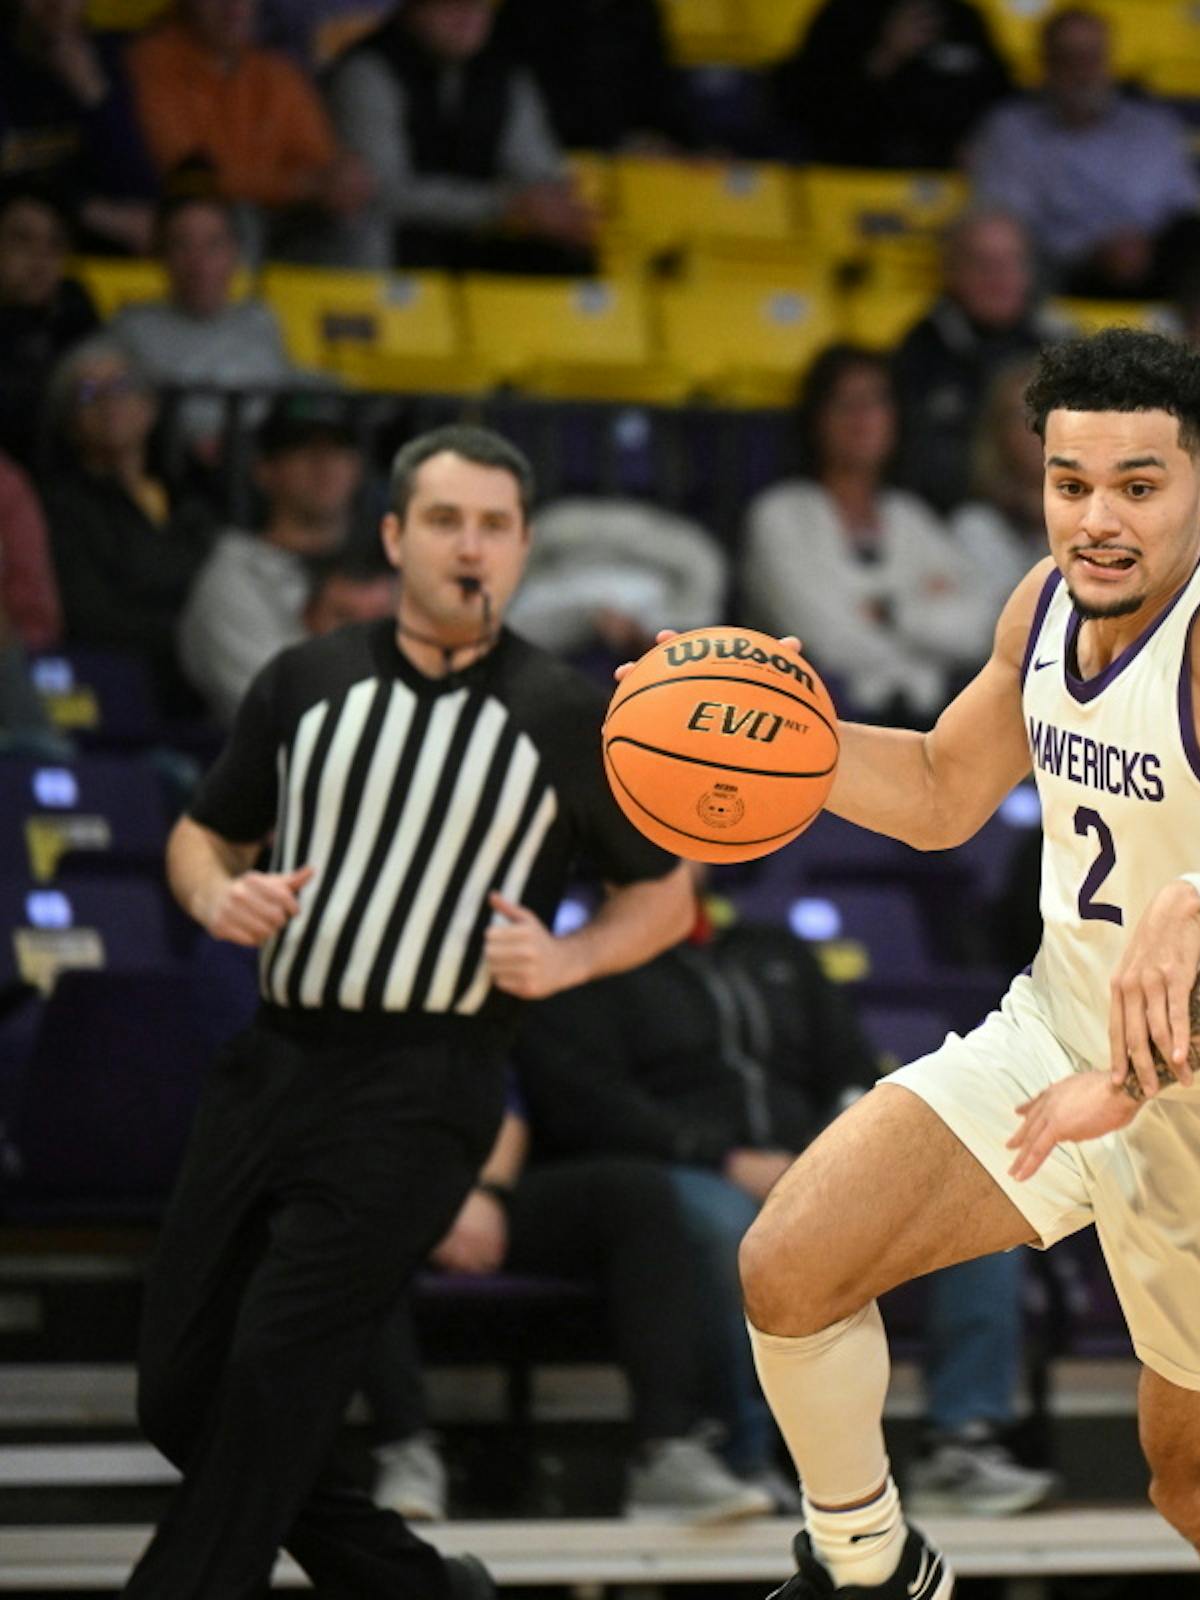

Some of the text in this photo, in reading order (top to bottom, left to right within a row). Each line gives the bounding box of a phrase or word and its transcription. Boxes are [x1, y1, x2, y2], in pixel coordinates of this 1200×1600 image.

[664, 638, 817, 696] Wilson
[687, 701, 784, 743] EVO
[1029, 716, 1165, 802] MAVERICKS
[1073, 805, 1124, 927] 2
